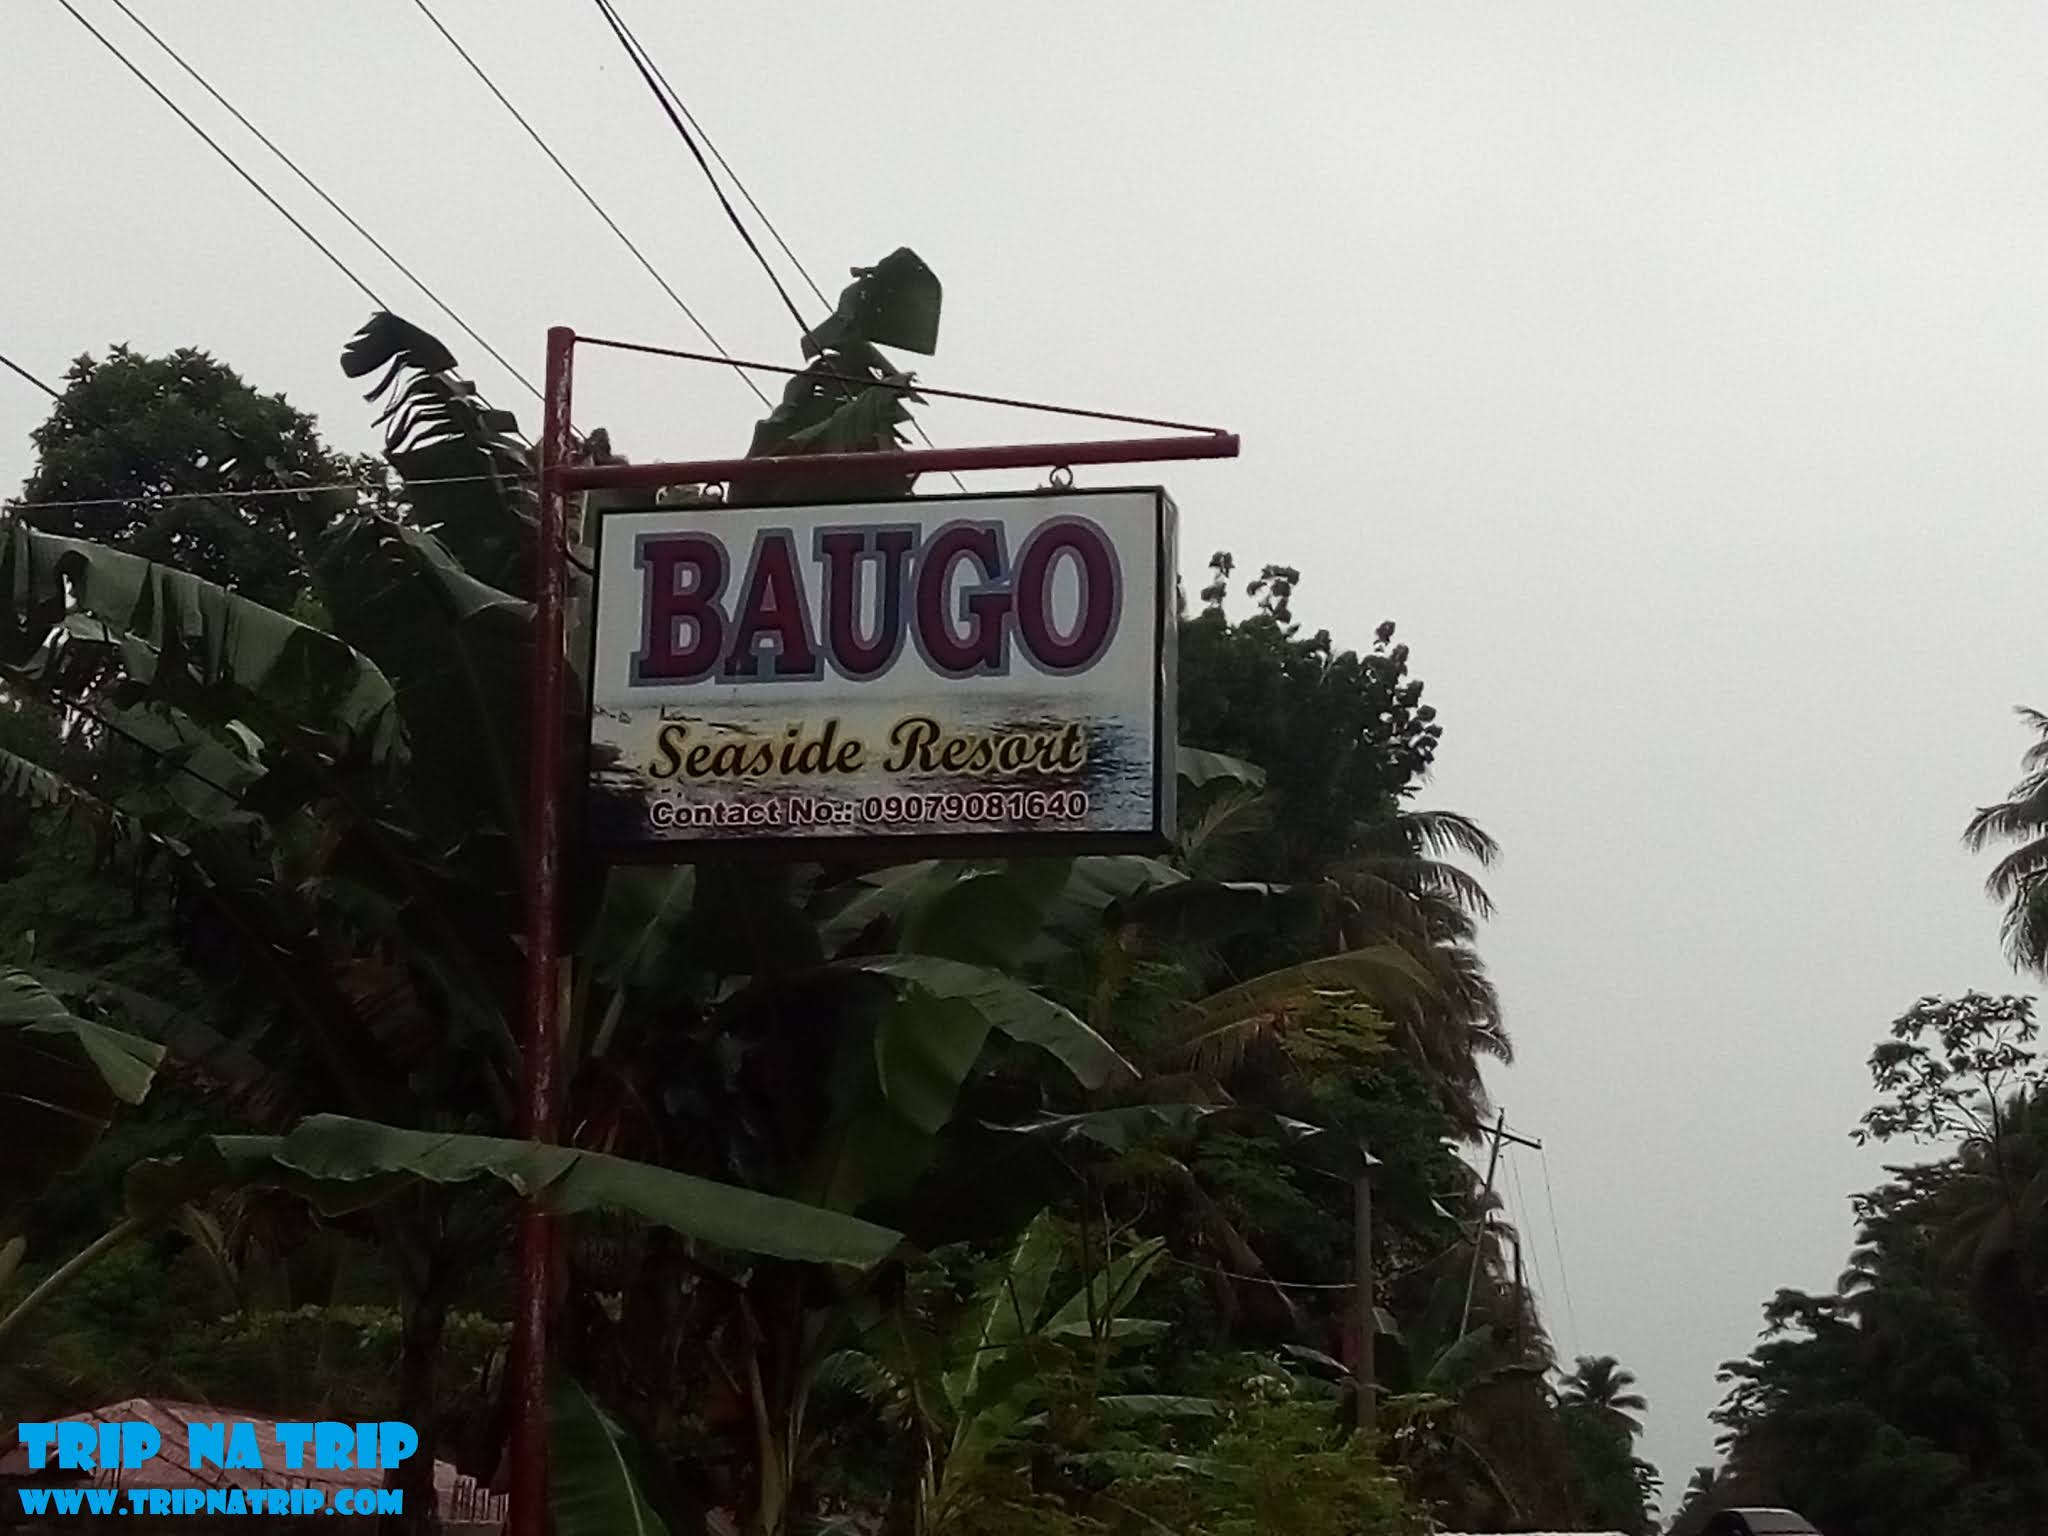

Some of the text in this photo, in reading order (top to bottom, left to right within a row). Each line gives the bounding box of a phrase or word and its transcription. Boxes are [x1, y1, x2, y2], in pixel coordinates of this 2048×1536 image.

[629, 514, 1123, 687] BAUGO
[649, 717, 1085, 779] Seaside Resort
[650, 799, 781, 827] Contact
[863, 791, 1087, 822] 09079081640
